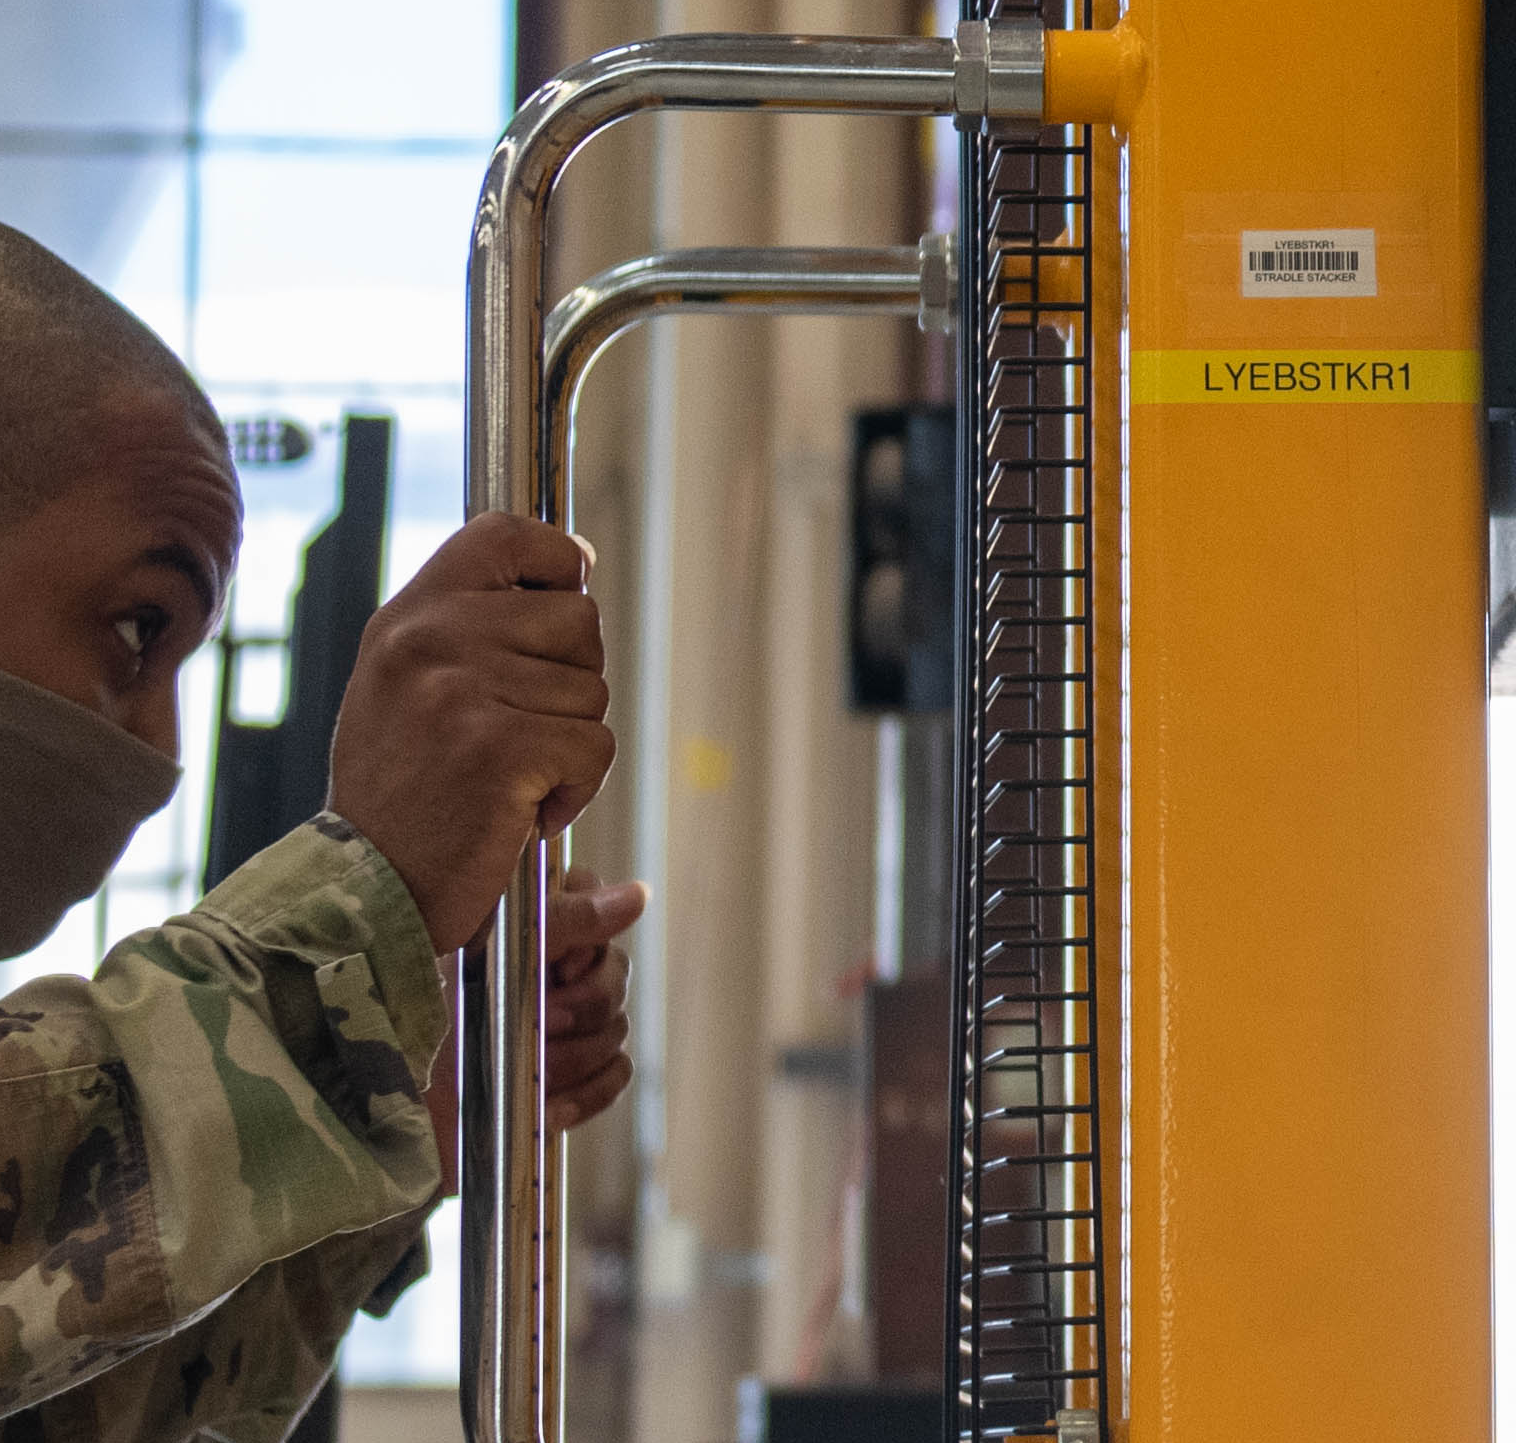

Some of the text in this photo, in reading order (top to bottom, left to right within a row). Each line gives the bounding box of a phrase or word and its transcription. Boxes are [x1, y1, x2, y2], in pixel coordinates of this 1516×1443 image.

[1274, 240, 1335, 250] LYEBSTKR1
[1254, 272, 1356, 283] STRADLE STACKER
[1204, 362, 1412, 391] LYEBSTKR1
